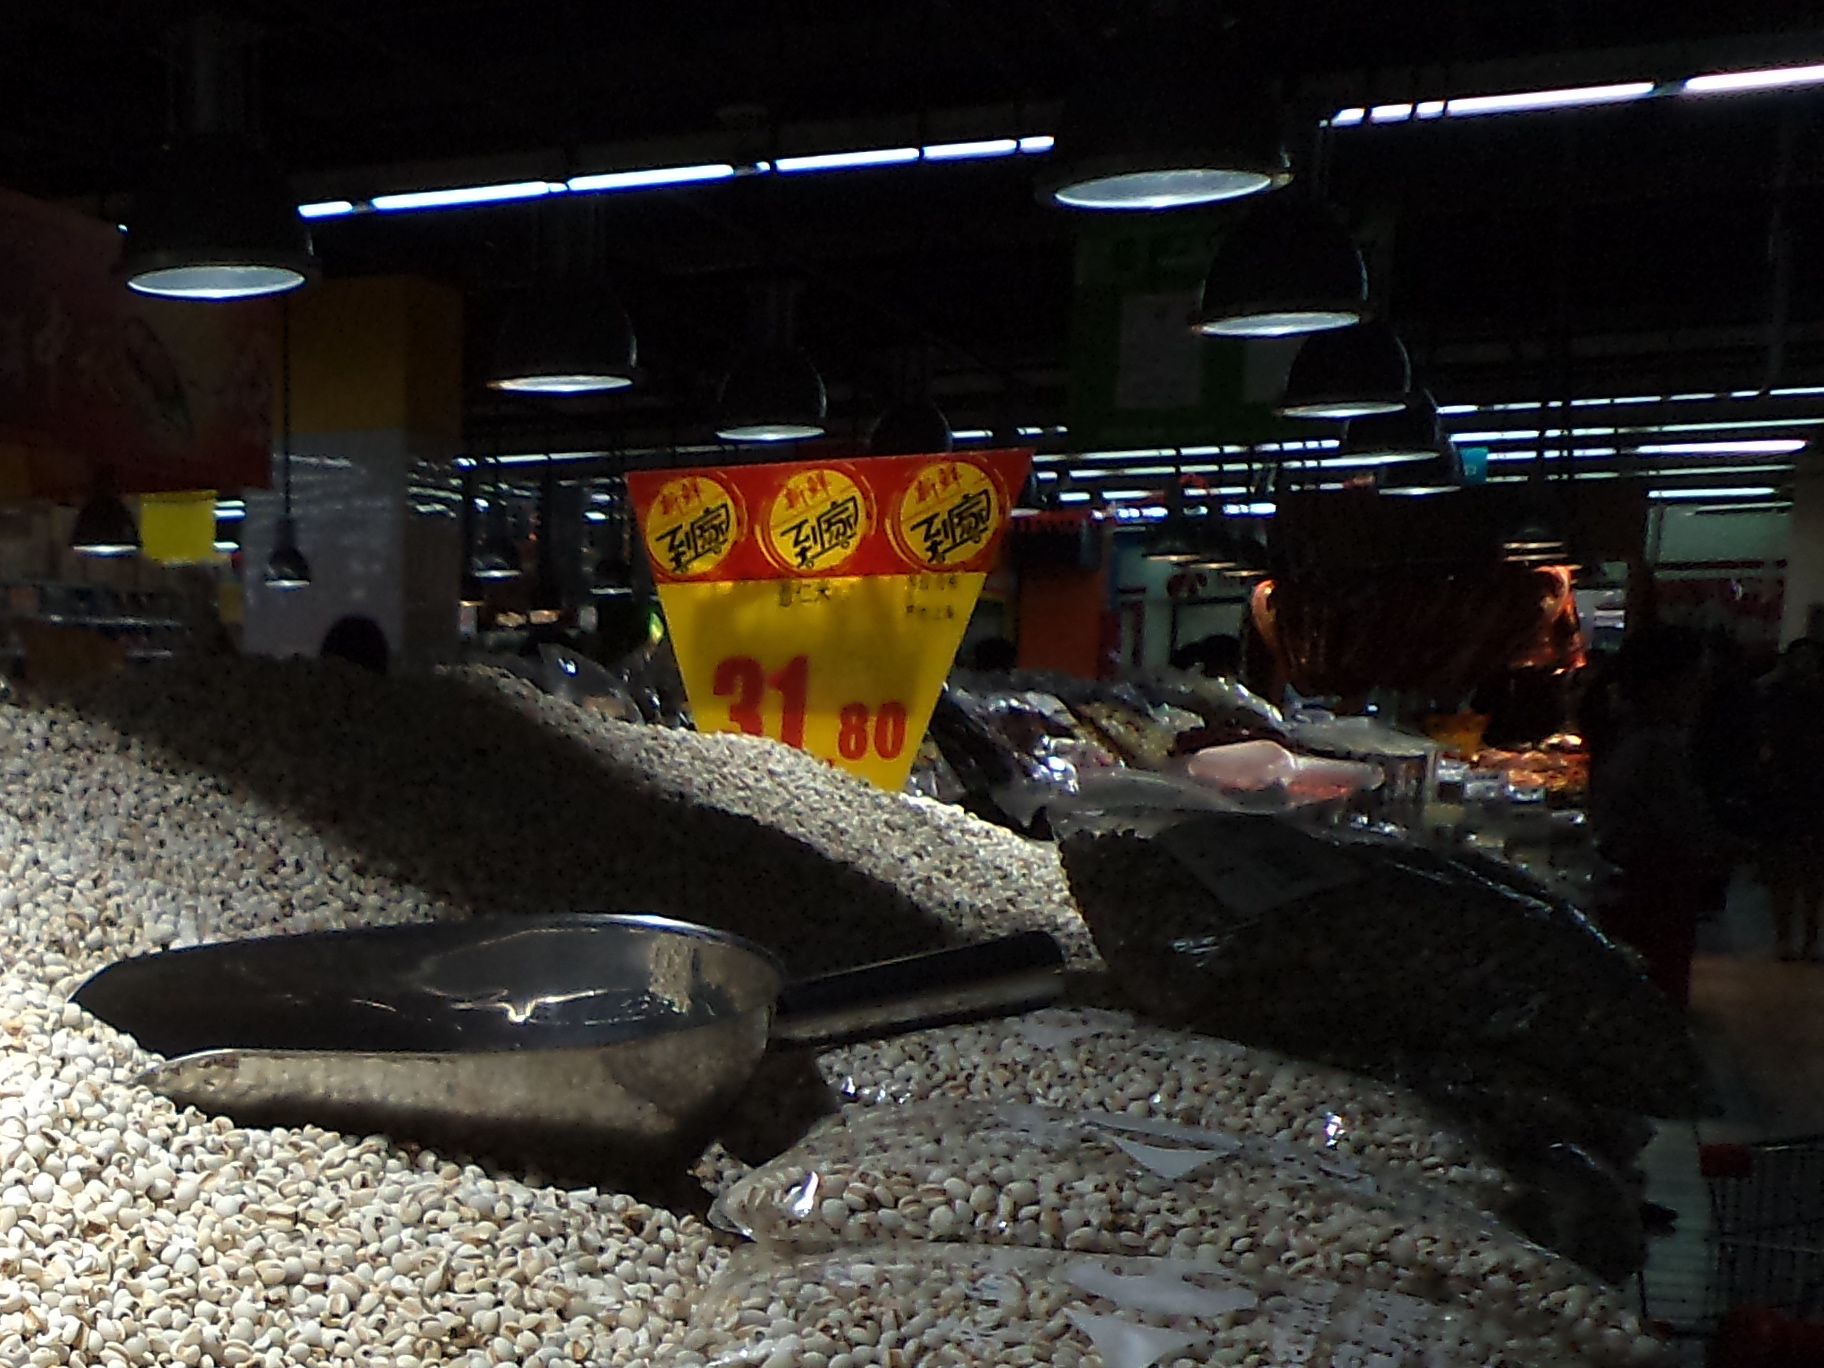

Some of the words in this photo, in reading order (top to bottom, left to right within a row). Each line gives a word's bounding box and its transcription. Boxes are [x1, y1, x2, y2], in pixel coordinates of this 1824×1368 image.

[655, 502, 729, 573] 到家
[780, 495, 858, 569] 到家
[910, 488, 992, 564] 到家
